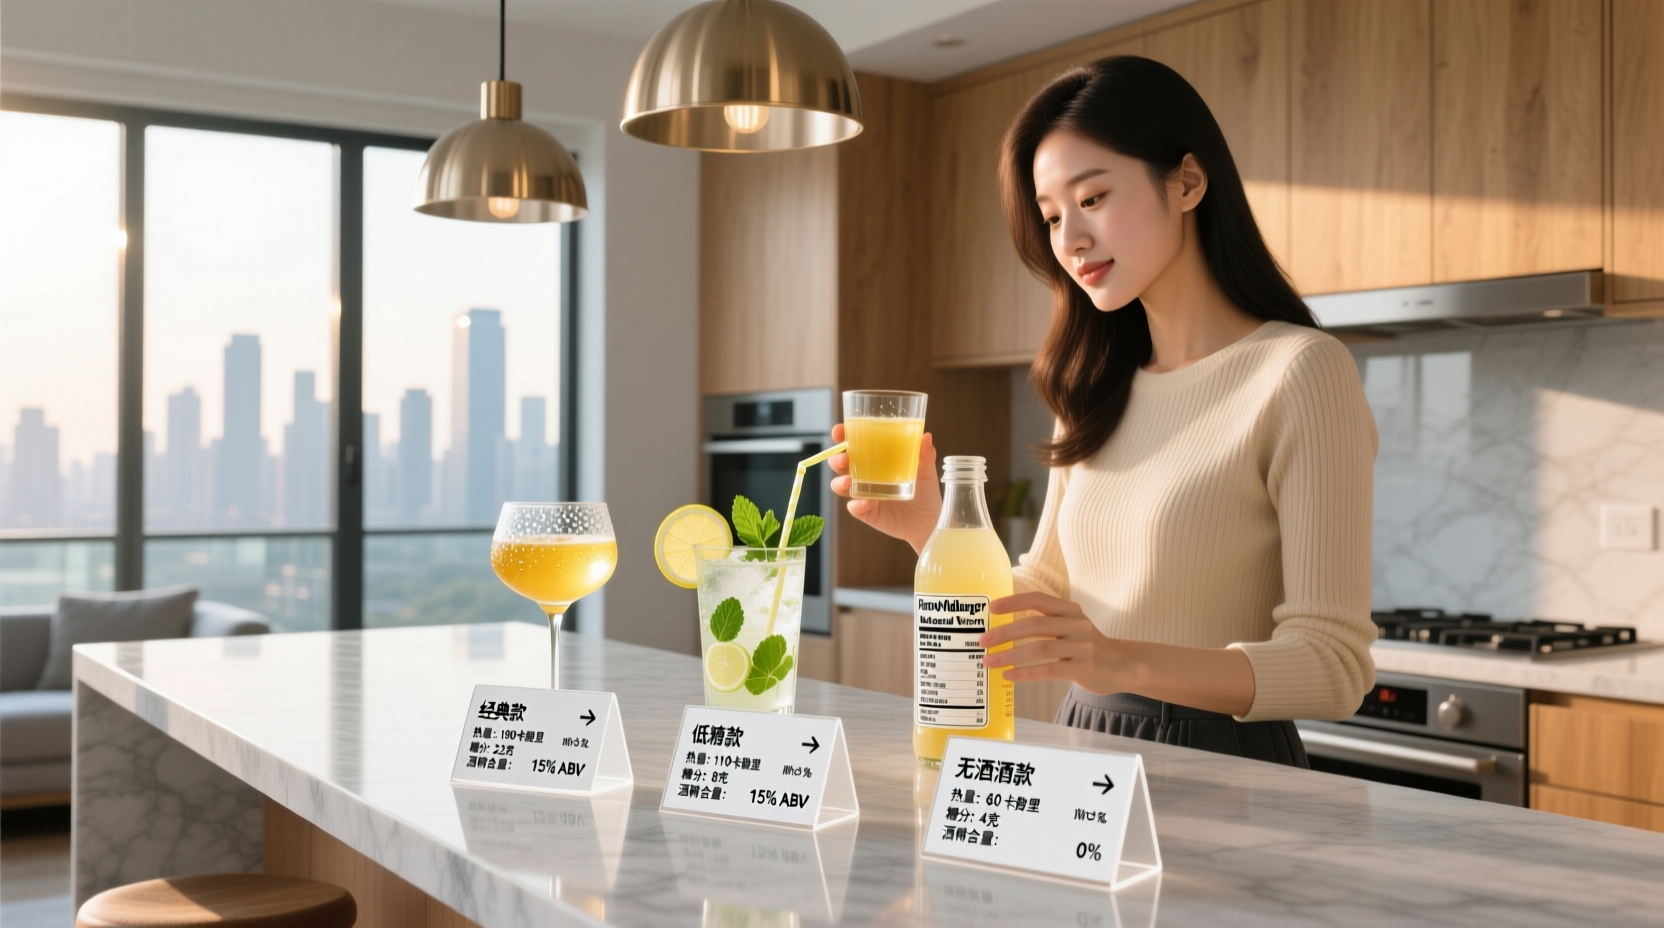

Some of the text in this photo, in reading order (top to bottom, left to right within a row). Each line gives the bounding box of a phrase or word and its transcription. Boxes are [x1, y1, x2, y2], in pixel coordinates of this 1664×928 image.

[532, 759, 556, 774] 15%
[558, 762, 585, 776] ABV
[955, 757, 1035, 786] 无酒酒款
[750, 789, 776, 806] 15%
[779, 792, 809, 809] ABV
[1076, 842, 1101, 861] 0%
